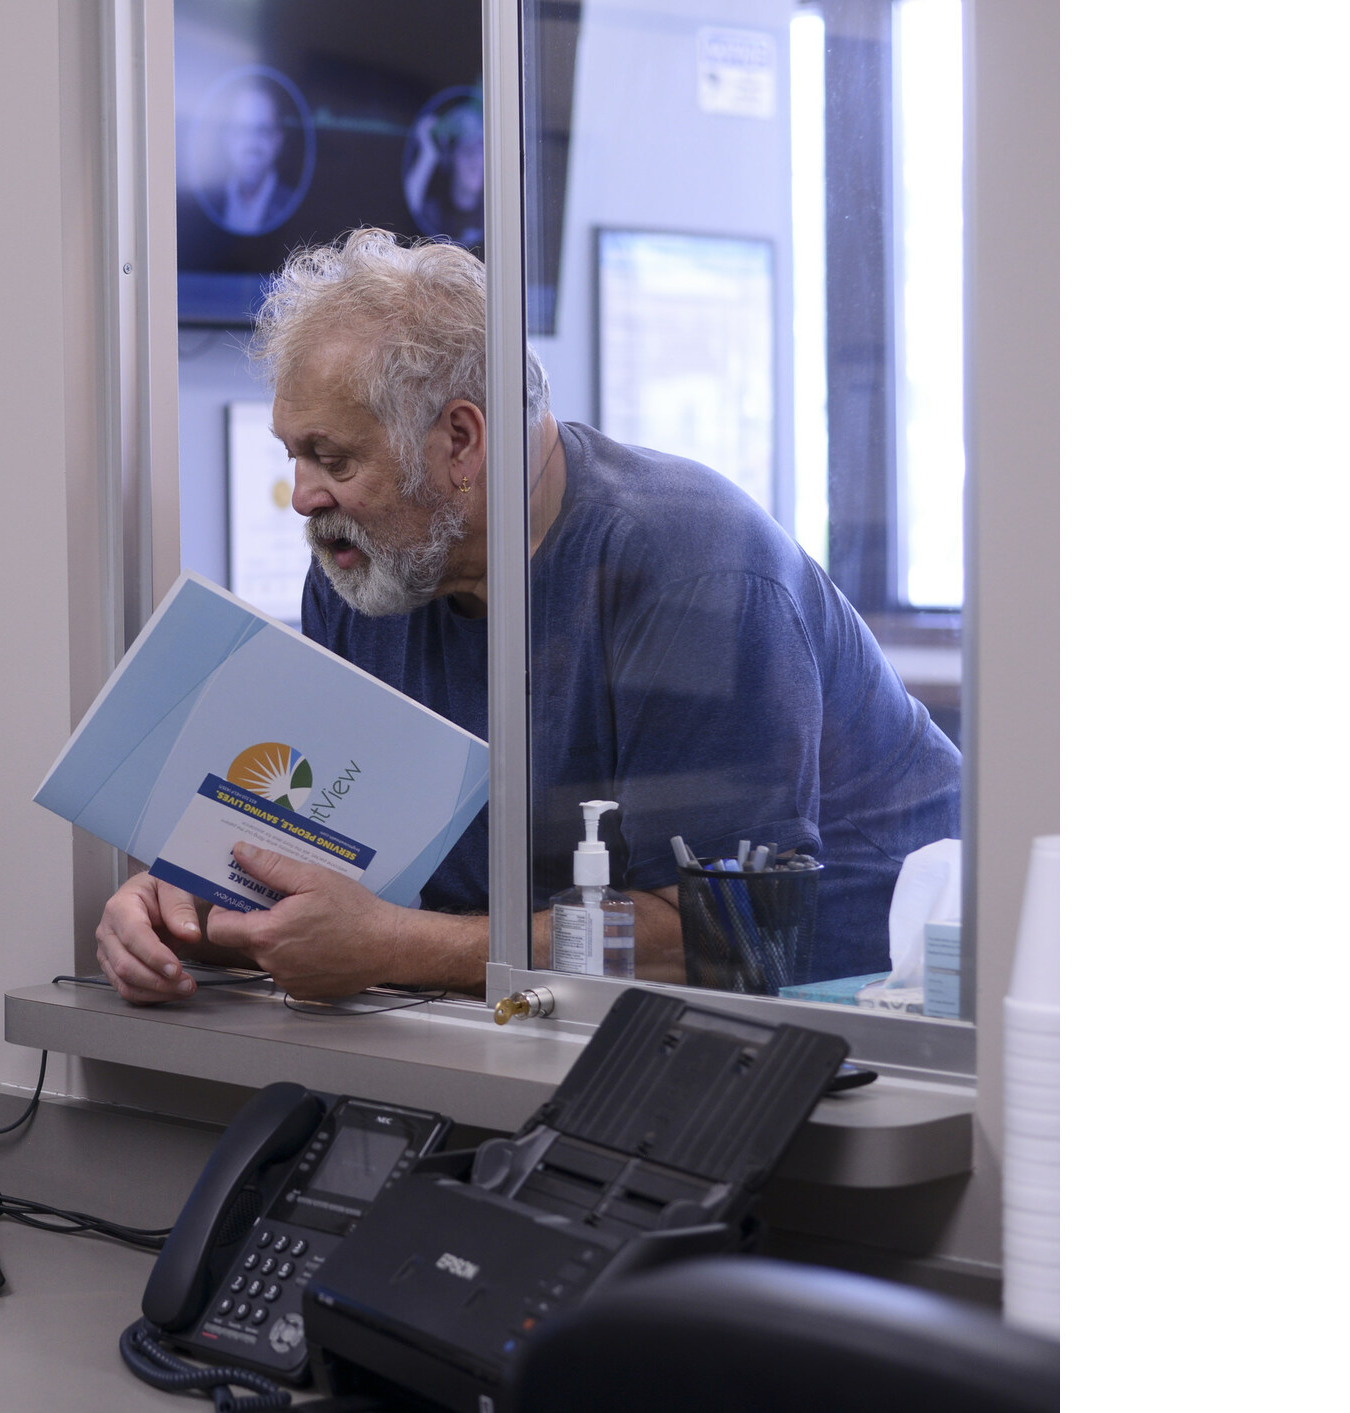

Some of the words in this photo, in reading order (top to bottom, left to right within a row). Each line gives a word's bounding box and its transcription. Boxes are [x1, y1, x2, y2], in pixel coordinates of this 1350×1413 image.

[215, 789, 244, 808] LIVES.
[244, 803, 279, 824] SAVING
[280, 819, 317, 842] PEOPLE,
[317, 837, 357, 860] SERVING
[228, 872, 266, 894] INTAKE
[435, 1252, 480, 1281] EPSON
